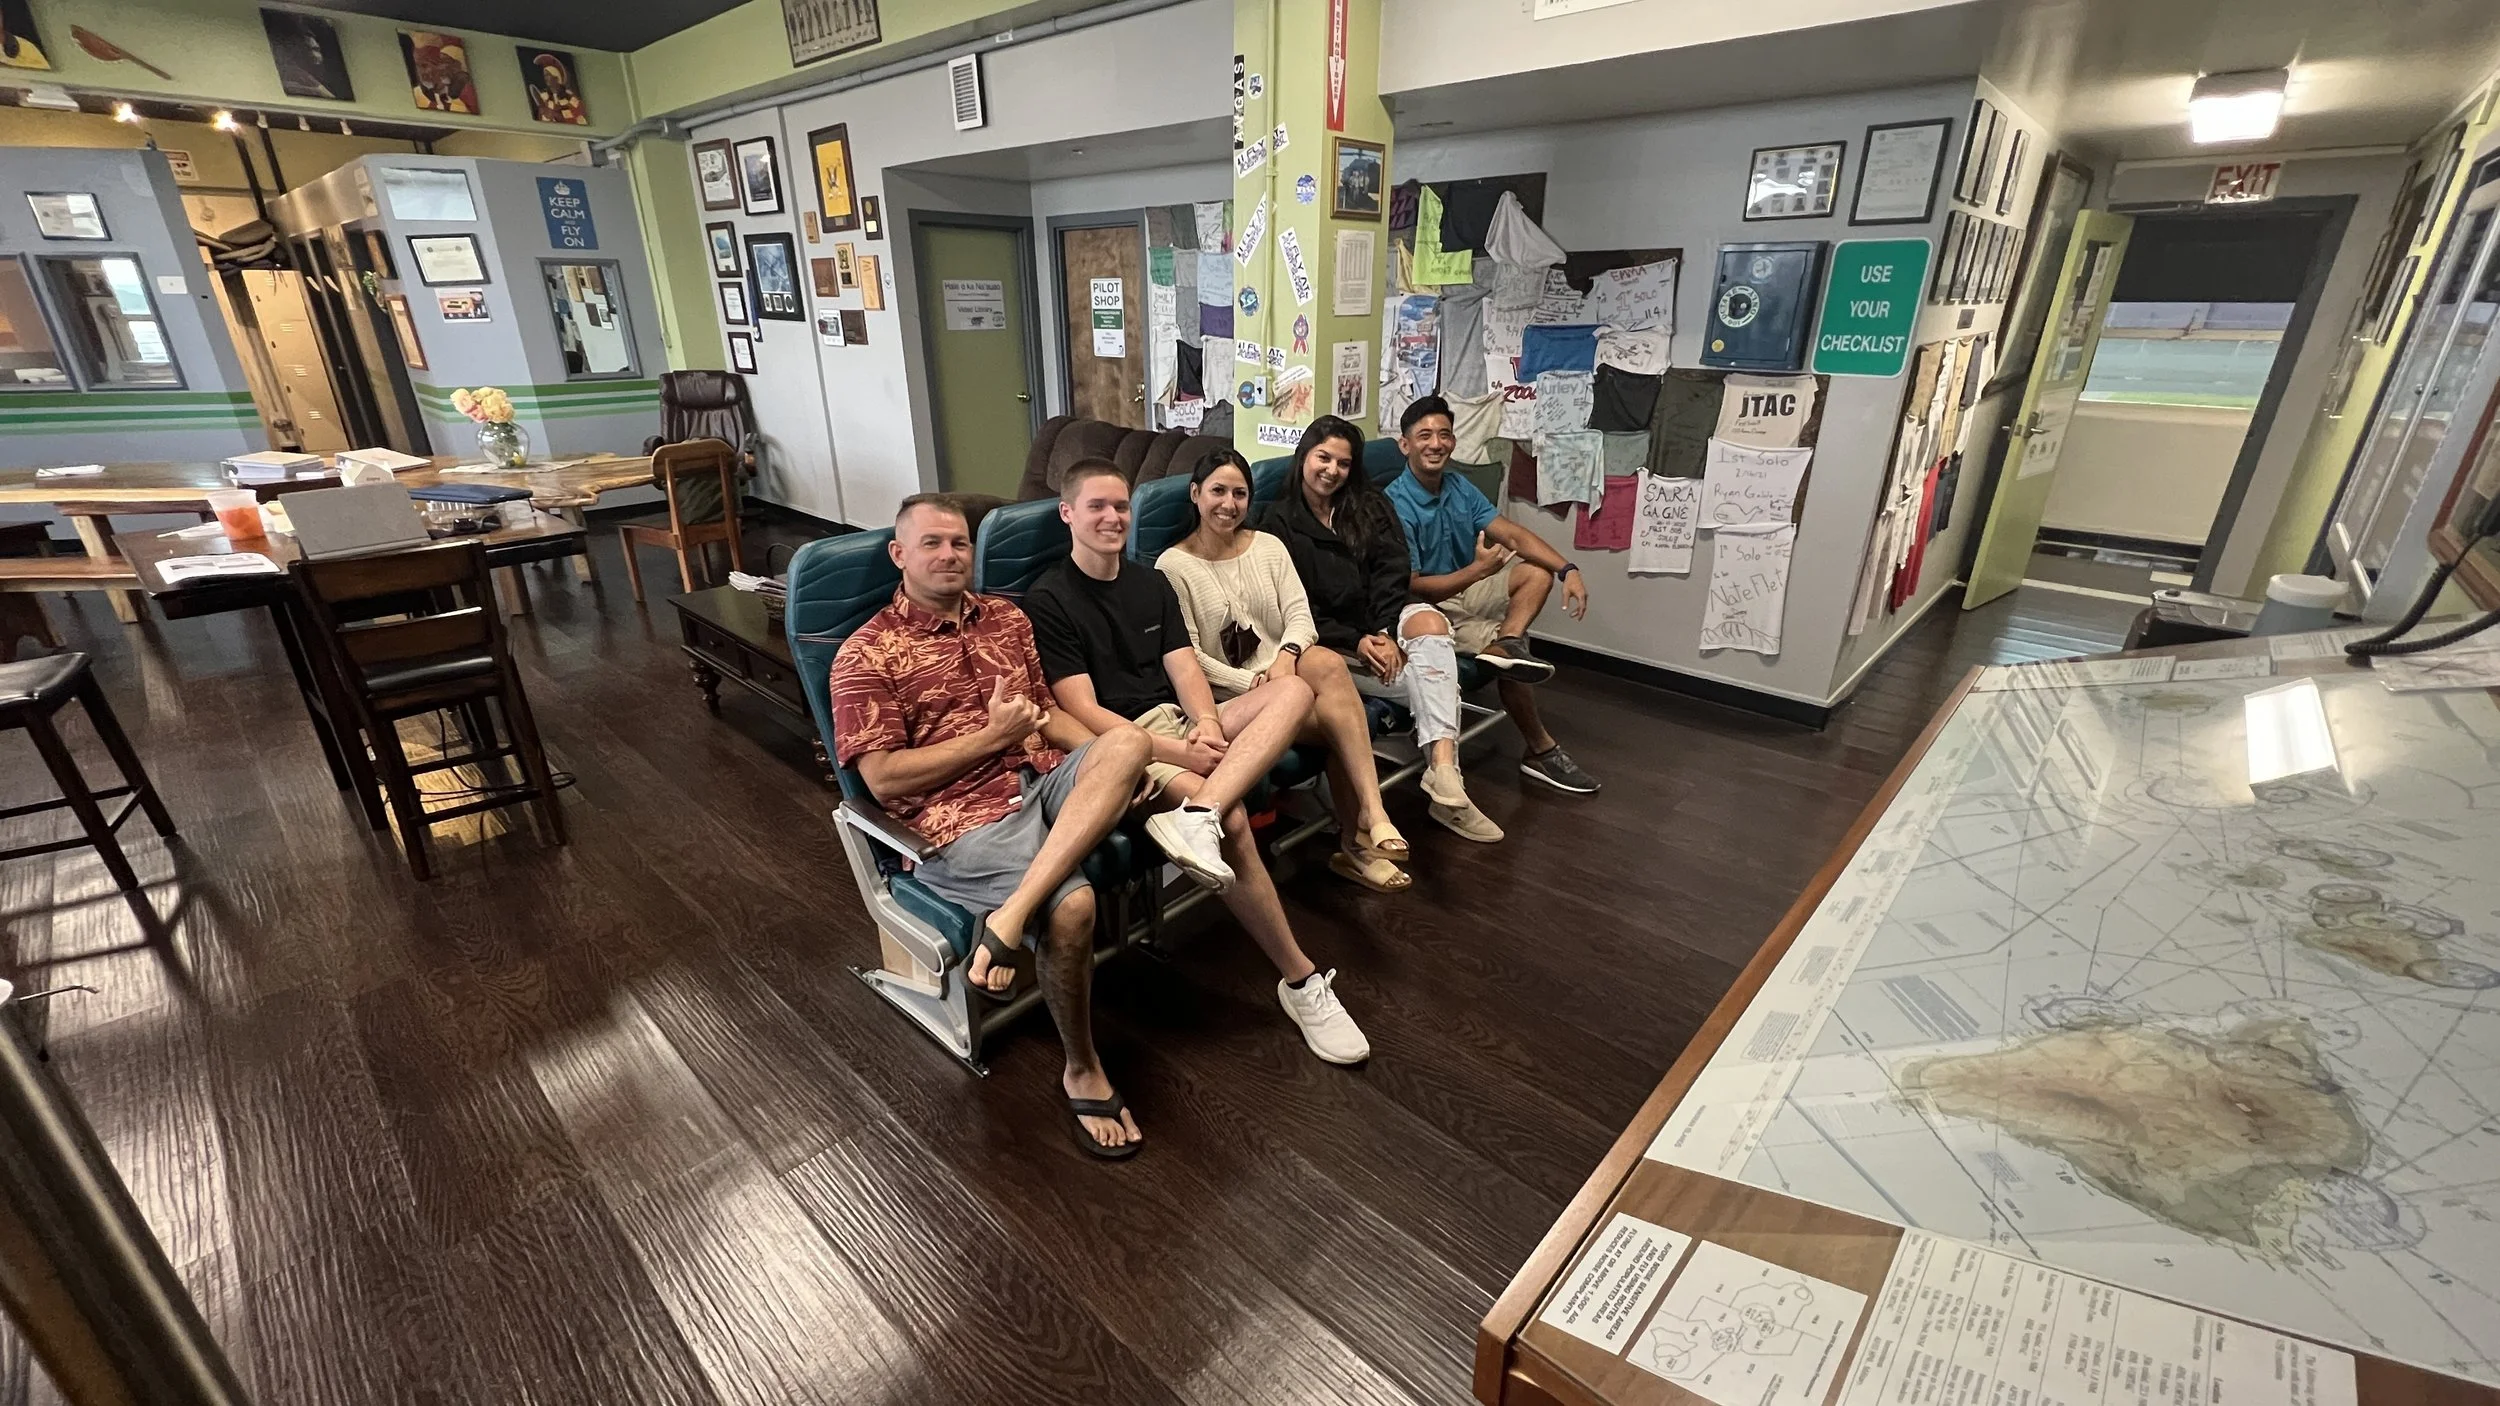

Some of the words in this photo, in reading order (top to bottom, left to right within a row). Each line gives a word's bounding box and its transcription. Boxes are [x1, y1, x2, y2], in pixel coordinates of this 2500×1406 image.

[1332, 11, 1341, 100] EXTINGUISHER
[2210, 163, 2281, 199] EXIT
[548, 196, 580, 207] KEEP
[550, 208, 585, 219] CALM
[560, 225, 580, 236] FLY
[564, 237, 585, 247] ON
[1860, 265, 1893, 283] USE
[1093, 282, 1120, 293] PILOT
[1094, 295, 1120, 306] SHOP
[1850, 300, 1891, 318] YOUR
[1821, 334, 1905, 353] CHECKLIST
[1738, 393, 1796, 418] JTAC
[1644, 483, 1697, 503] SARA
[1714, 483, 1741, 500] Ryan
[1736, 544, 1761, 560] Solo
[1605, 1225, 1629, 1253] REDUCES
[1618, 1227, 1639, 1250] FLYING
[1612, 1248, 1624, 1258] AT
[1631, 1236, 1654, 1264] AROUND
[1643, 1245, 1659, 1261] AND
[1655, 1241, 1674, 1262] AVOID
[1589, 1252, 1610, 1273] NOISE
[1636, 1260, 1649, 1273] FLY
[1641, 1260, 1661, 1282] NOISE
[1590, 1266, 1611, 1289] ABOVE
[1606, 1263, 1636, 1301] POPULATED
[1621, 1271, 1642, 1294] USING
[1560, 1272, 1595, 1315] COMPLAINTS
[1619, 1280, 1648, 1316] SENSITIVE
[1564, 1310, 1580, 1325] AGL
[1590, 1299, 1612, 1324] AREAS
[1604, 1293, 1628, 1321] ROUTES
[1603, 1315, 1625, 1341] AREAS
